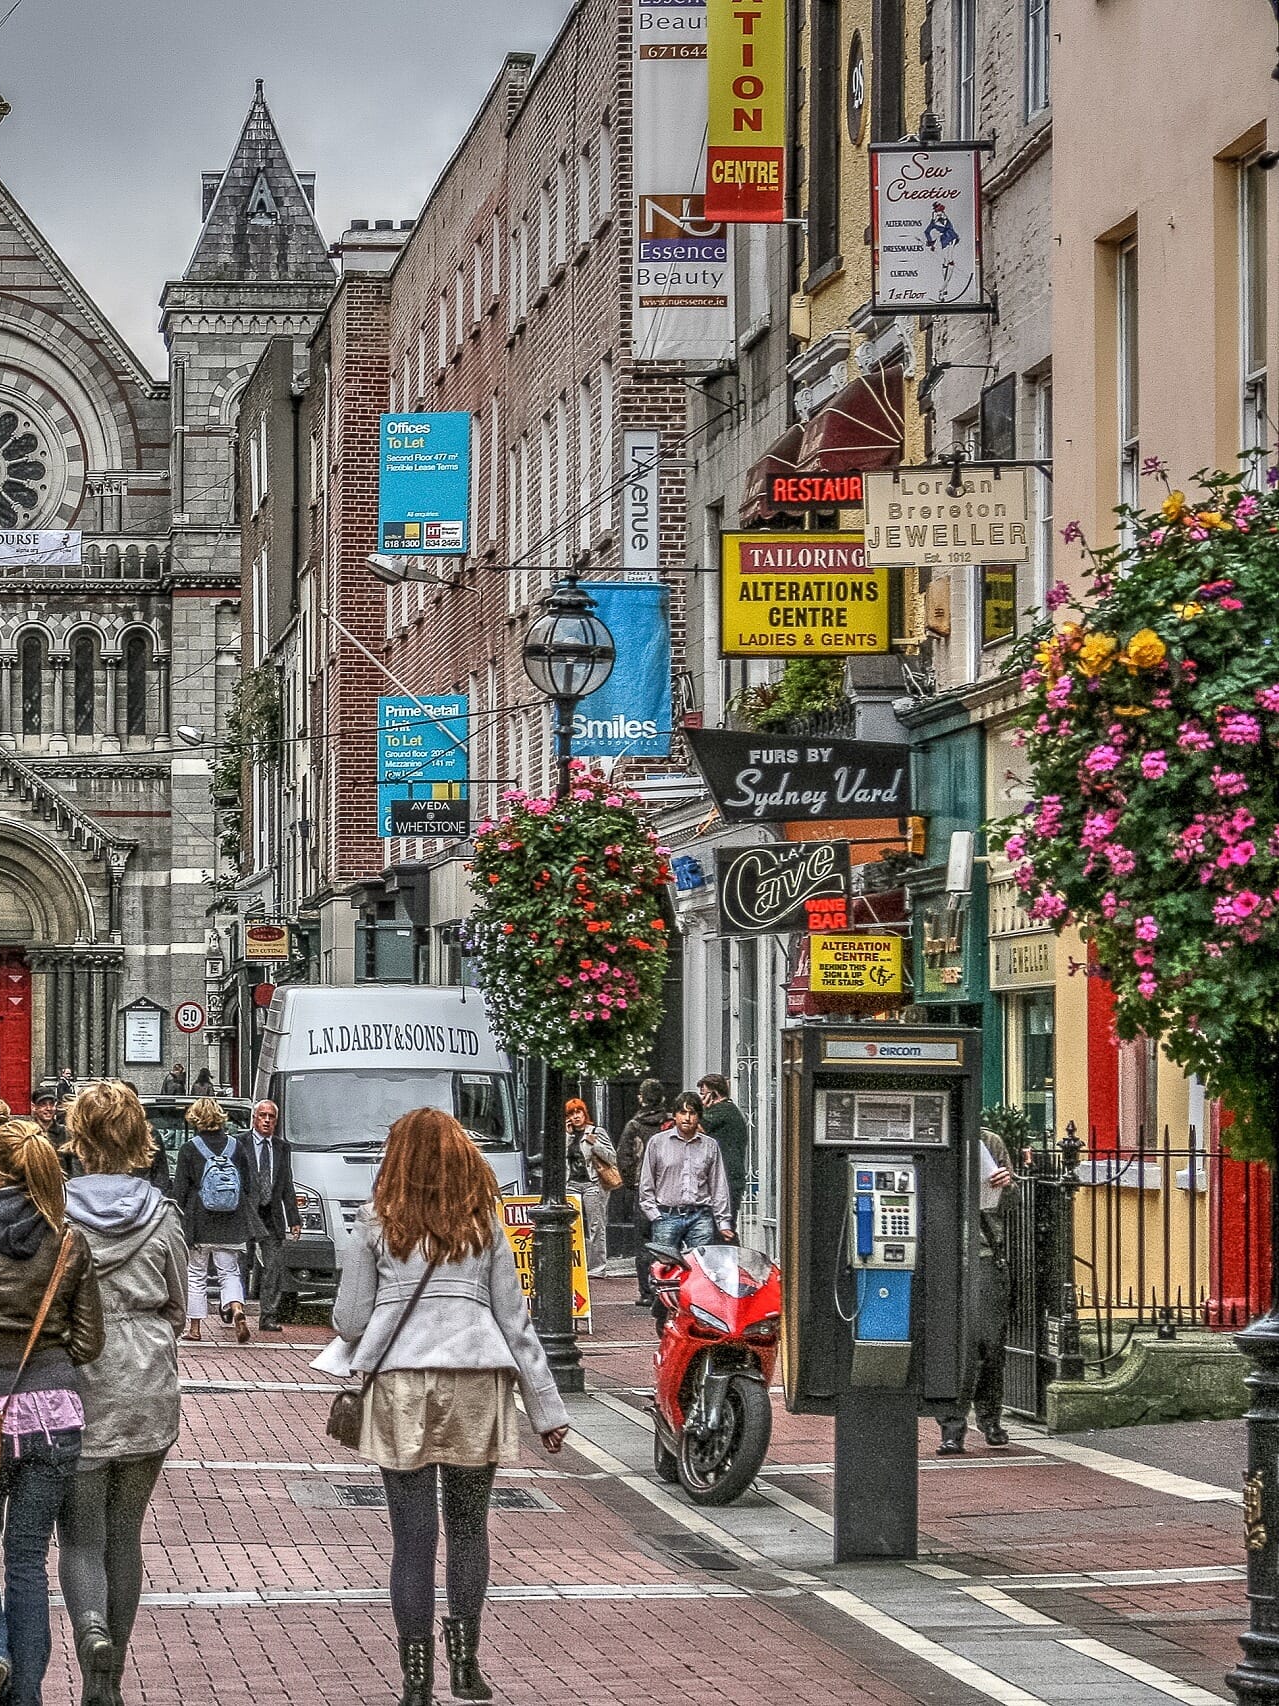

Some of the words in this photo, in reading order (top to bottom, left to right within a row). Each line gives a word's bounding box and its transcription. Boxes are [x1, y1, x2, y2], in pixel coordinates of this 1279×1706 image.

[640, 13, 707, 30] Beau
[732, 0, 765, 132] TION
[711, 160, 779, 184] CENTRE
[901, 153, 952, 181] Sew
[887, 179, 961, 202] Creative
[885, 220, 922, 228] ALTERATIONS
[640, 242, 725, 259] Essence
[637, 268, 723, 288] Beauty
[387, 422, 430, 434] Offices
[387, 437, 401, 448] To
[404, 437, 425, 448] Let
[387, 454, 413, 462] Second
[415, 453, 433, 461] Floor
[901, 477, 993, 496] Loran
[888, 502, 1007, 521] Brereton
[868, 522, 1026, 549] JEWELLER
[739, 581, 879, 602] ALTERATIONS
[769, 607, 848, 628] CENTRE
[739, 633, 797, 646] LADIES
[804, 633, 815, 646] &
[825, 633, 877, 647] GENTS
[385, 705, 421, 717] Prime
[424, 704, 459, 716] Retail
[572, 714, 657, 739] Smiles
[385, 735, 400, 746] To
[403, 735, 422, 746] Let
[749, 750, 798, 764] FURS
[807, 748, 832, 762] BY
[724, 768, 827, 817] Sydney
[834, 766, 904, 803] Vard
[411, 802, 450, 810] AVEDA
[396, 821, 466, 833] WHETSTONE
[805, 898, 846, 912] WINE
[809, 913, 847, 929] BAR
[821, 942, 891, 951] ALTERATION
[834, 952, 879, 961] CENTRE
[182, 1009, 197, 1022] 50
[449, 1027, 479, 1056] LTD
